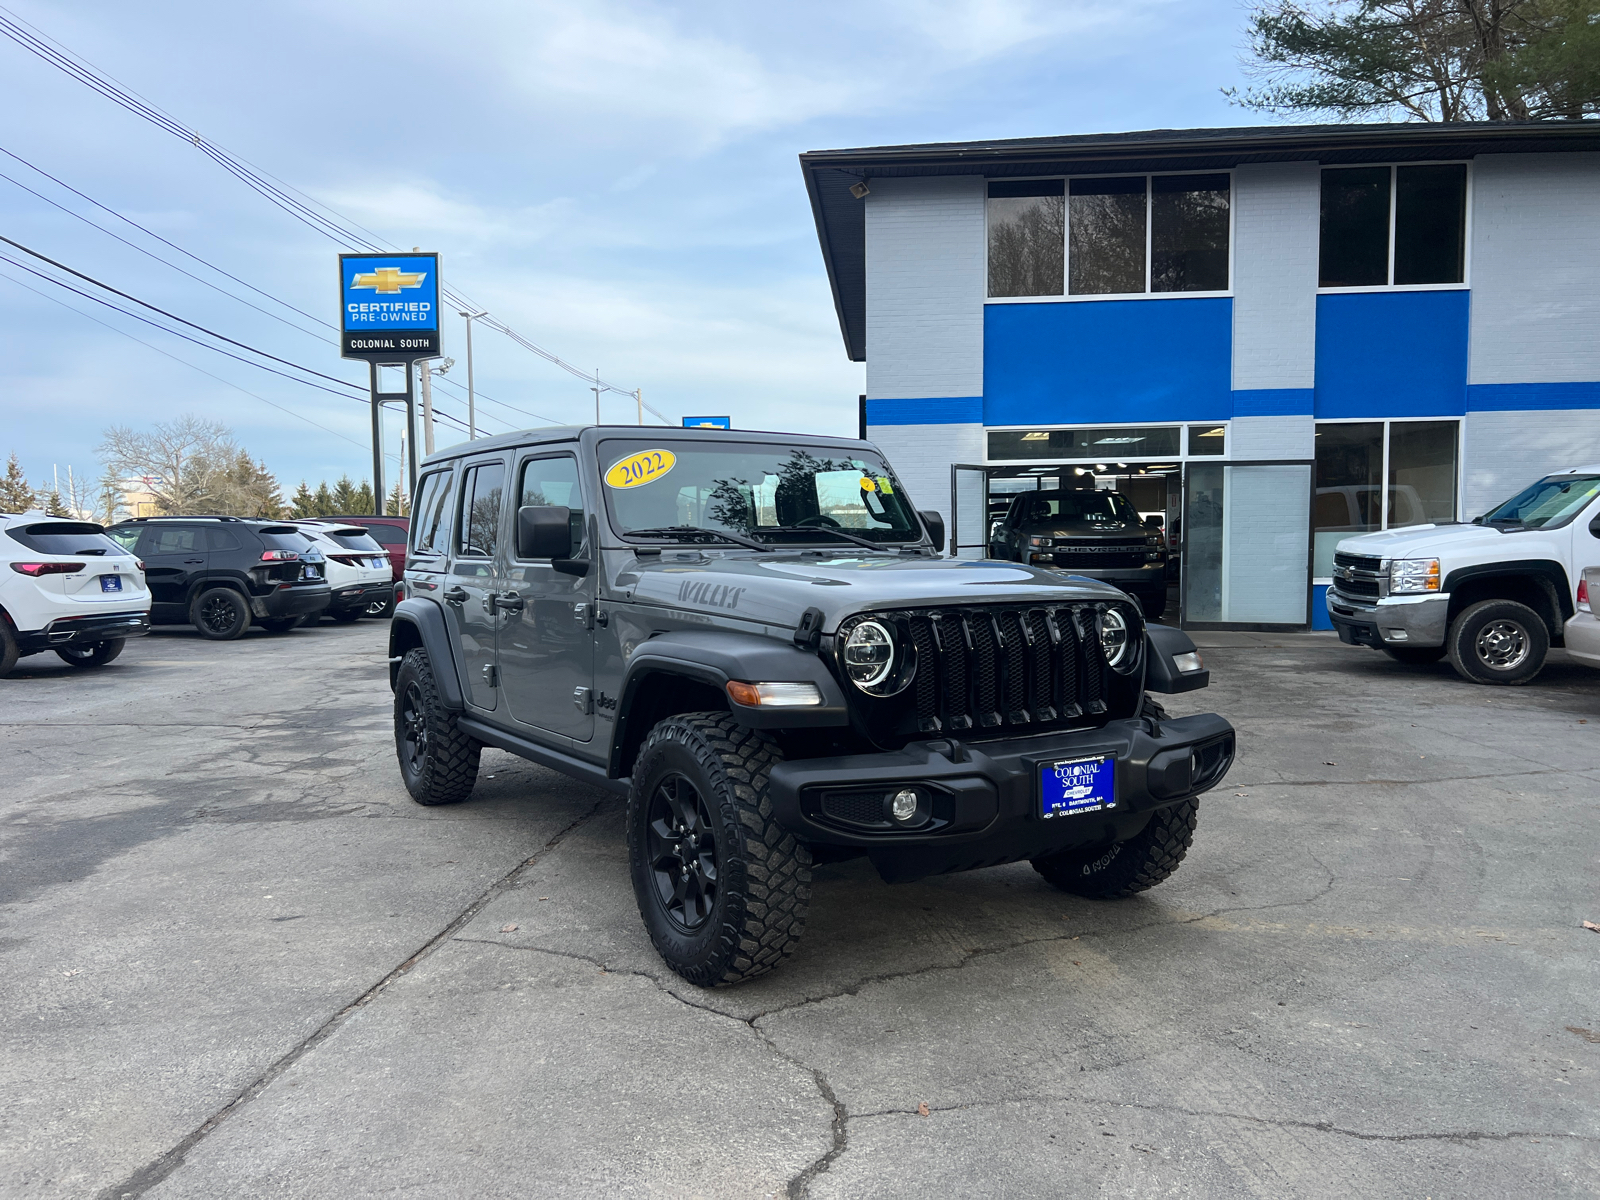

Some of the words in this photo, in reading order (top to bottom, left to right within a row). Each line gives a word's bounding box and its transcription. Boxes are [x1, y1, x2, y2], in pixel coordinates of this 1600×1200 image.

[347, 302, 431, 313] CERTIFIED
[352, 312, 427, 322] PRE-OWNED
[351, 339, 395, 349] COLONIAL
[400, 339, 430, 348] SOUTH
[620, 452, 665, 485] 2022
[678, 580, 746, 609] WILLYS
[1055, 763, 1101, 779] COLONIAL
[1062, 774, 1094, 787] SOUTH
[1066, 788, 1091, 796] CHEVROLET
[1059, 808, 1085, 816] COLONIAL
